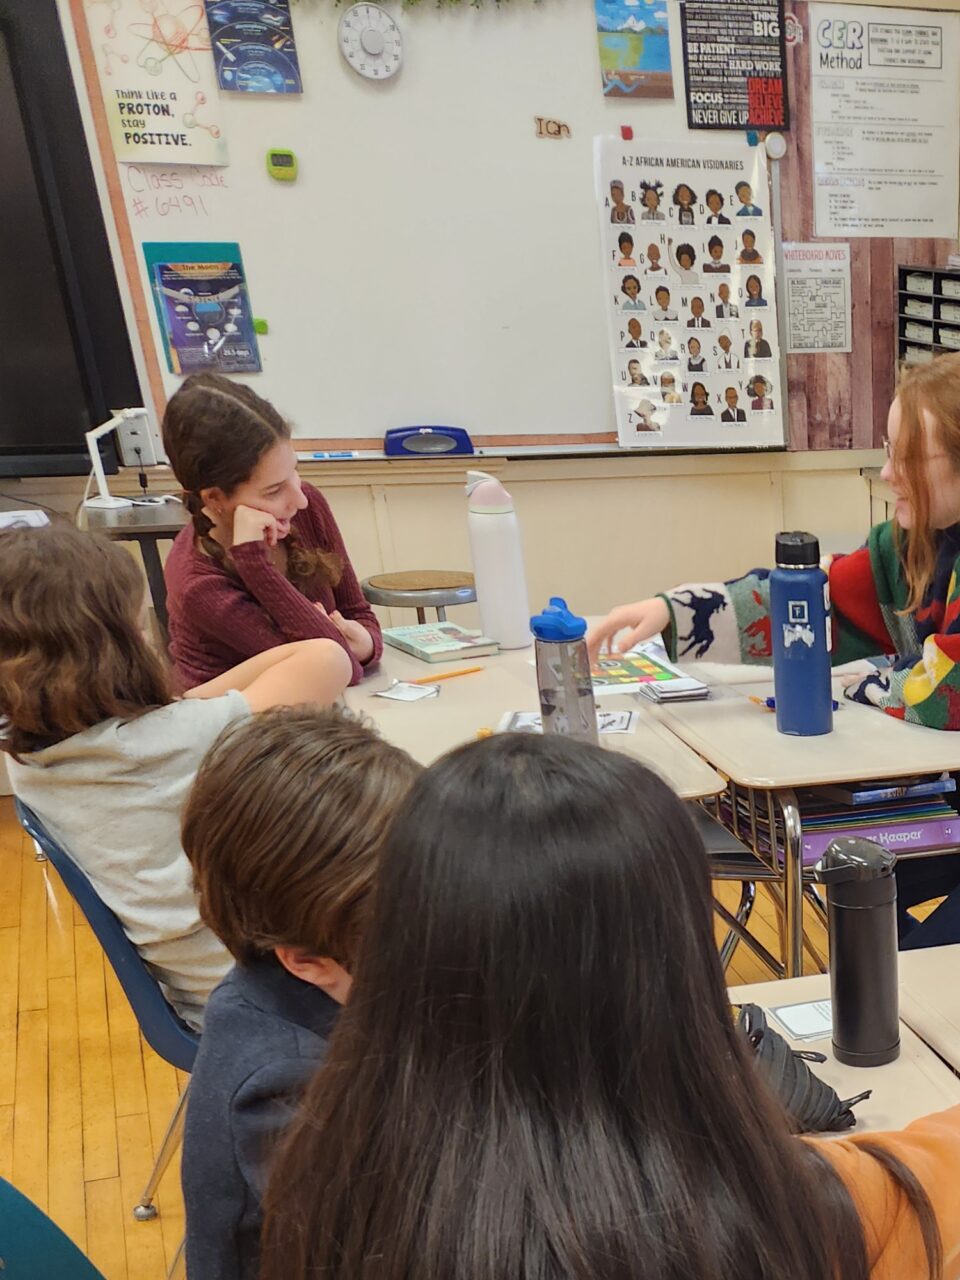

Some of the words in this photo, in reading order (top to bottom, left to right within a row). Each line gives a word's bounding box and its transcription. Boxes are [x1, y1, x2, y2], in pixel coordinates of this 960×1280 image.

[752, 11, 779, 21] THINK
[753, 21, 780, 37] BIG
[817, 19, 864, 49] CER
[700, 43, 735, 54] PATIENT
[729, 60, 754, 70] HARD
[754, 61, 782, 72] WORK
[820, 50, 862, 70] Method
[748, 77, 782, 94] DREAM
[115, 89, 142, 100] Think
[170, 92, 177, 101] a
[689, 92, 724, 104] FOCUS
[749, 94, 784, 109] BELIEVE
[118, 102, 175, 118] PROTON,
[692, 109, 719, 124] NEVER
[720, 110, 737, 124] GIVE
[739, 110, 750, 125] UP
[124, 132, 192, 146] POSITIVE.
[636, 156, 664, 167] AFRICAN
[666, 158, 701, 169] AMERICAN
[703, 160, 744, 171] VISIONARIES
[128, 165, 184, 192] Class
[880, 829, 923, 844] Keeper
